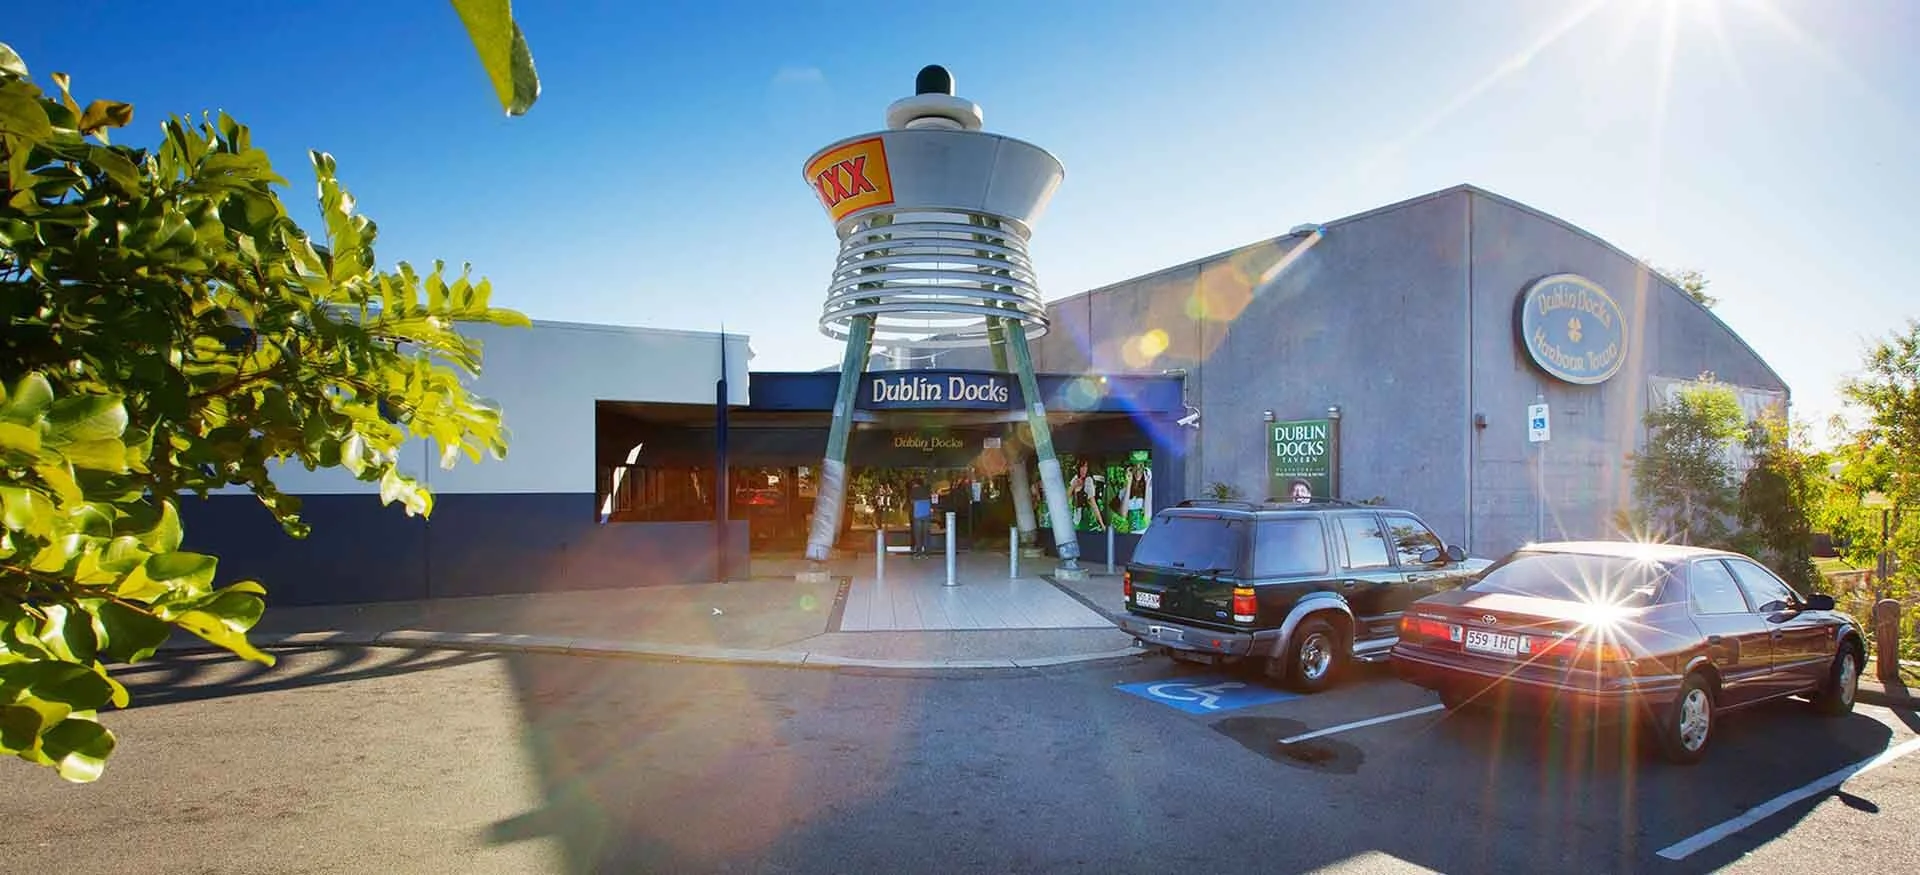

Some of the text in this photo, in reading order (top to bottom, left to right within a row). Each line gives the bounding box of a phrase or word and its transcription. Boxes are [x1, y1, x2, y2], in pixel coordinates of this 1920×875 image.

[1538, 286, 1611, 329] Dublin Docks
[1534, 326, 1617, 370] Harbour Town
[872, 376, 1008, 402] Dublin Docks
[895, 437, 963, 448] Dublin Docks
[1275, 425, 1325, 441] DUBLIN
[1276, 441, 1324, 456] DOCKS
[1468, 631, 1489, 646] 559
[1493, 635, 1516, 650] IHC
